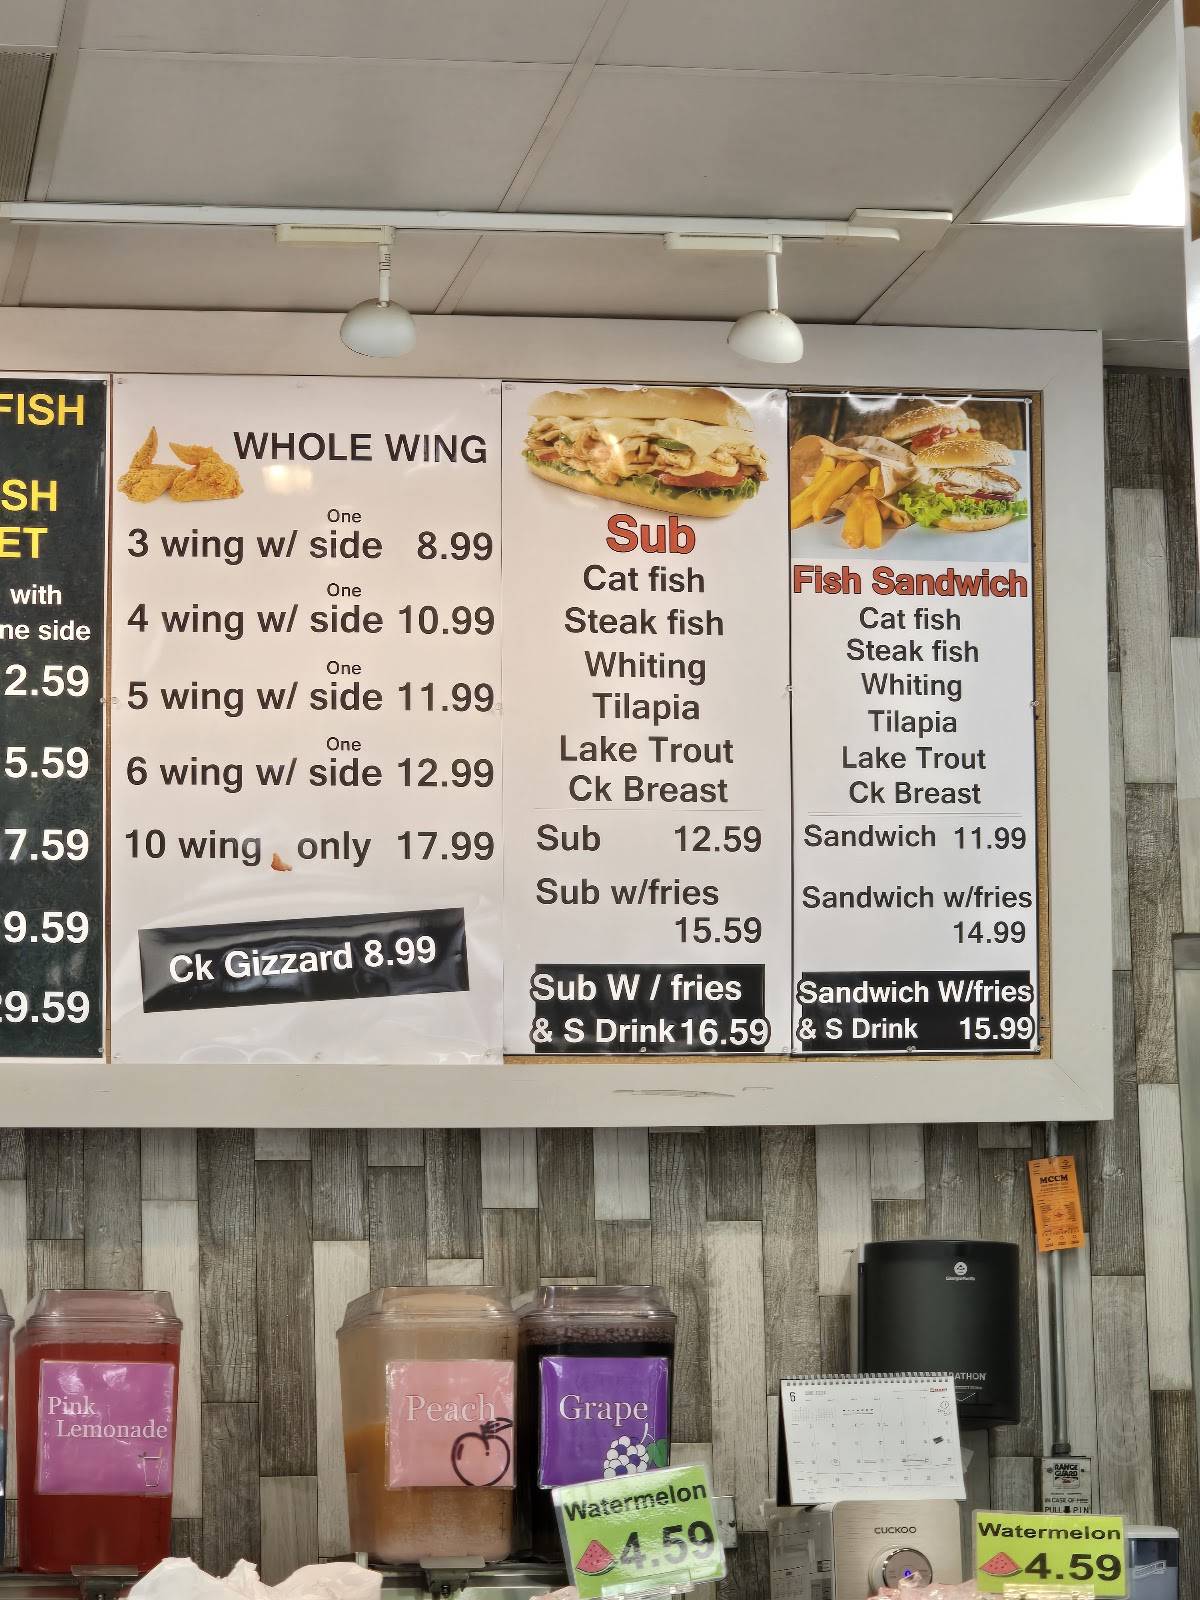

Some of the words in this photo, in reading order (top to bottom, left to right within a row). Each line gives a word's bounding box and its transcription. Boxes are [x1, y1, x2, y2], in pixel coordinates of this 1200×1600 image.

[234, 432, 372, 461] WHOLE
[385, 434, 486, 463] WING
[328, 509, 361, 522] One
[0, 527, 48, 558] ET
[128, 528, 148, 557] 3
[161, 529, 243, 565] wing
[257, 530, 298, 557] w/
[310, 530, 382, 558] side
[418, 531, 492, 560] 8.99
[605, 514, 697, 555] Sub
[327, 583, 361, 597] One
[584, 565, 638, 591] Cat
[649, 566, 704, 592] fish
[794, 565, 861, 594] Fish
[872, 566, 1027, 597] Sandwich
[10, 584, 61, 604] with
[39, 620, 90, 640] side
[128, 604, 148, 632] 4
[162, 604, 243, 640] wing
[257, 604, 298, 632] w/
[311, 605, 383, 633] side
[399, 605, 494, 635] 10.99
[565, 607, 657, 634] Steak
[667, 609, 723, 635] fish
[860, 607, 905, 629] Cat
[914, 608, 960, 630] fish
[847, 638, 923, 661] Steak
[932, 640, 978, 662] fish
[5, 664, 88, 696] 2.59
[327, 661, 361, 674] One
[585, 651, 705, 686] Whiting
[128, 682, 148, 709] 5
[161, 682, 243, 717] wing
[257, 682, 298, 709] w/
[310, 682, 382, 710] side
[399, 682, 493, 712] 11.99
[861, 673, 961, 702] Whiting
[592, 693, 699, 726] Tilapia
[868, 710, 956, 738] Tilapia
[327, 737, 361, 751] One
[561, 735, 637, 762] Lake
[649, 736, 733, 763] Trout
[843, 746, 906, 768] Lake
[916, 747, 986, 769] Trout
[5, 747, 88, 778] 5.59
[160, 757, 242, 793] wing
[256, 758, 297, 785] w/
[310, 758, 382, 786] side
[398, 758, 493, 787] 12.99
[569, 775, 612, 801] Ck
[625, 776, 728, 802] Breast
[850, 781, 885, 803] Ck
[896, 782, 981, 804] Breast
[5, 829, 88, 860] 7.59
[126, 830, 165, 858] 10
[179, 830, 260, 866] wing
[298, 831, 371, 867] only
[398, 831, 494, 860] 17.99
[537, 824, 600, 851] Sub
[675, 826, 761, 852] 12.59
[804, 824, 935, 847] Sandwich
[955, 827, 1026, 849] 11.99
[537, 878, 599, 904] Sub
[611, 879, 718, 905] w/fries
[803, 886, 933, 908] Sandwich
[944, 886, 1032, 908] w/fries
[4, 911, 88, 943] 9.59
[676, 917, 761, 943] 15.59
[954, 921, 1025, 943] 14.99
[169, 954, 214, 982] Ck
[225, 942, 352, 978] Gizzard
[365, 936, 435, 967] 8.99
[532, 975, 596, 1001] Sub
[607, 974, 640, 1000] W
[671, 974, 741, 1000] fries
[799, 981, 929, 1004] Sandwich
[938, 982, 1032, 1004] W/fries
[0, 991, 89, 1023] 9.59
[532, 1018, 552, 1043] &
[564, 1018, 584, 1042] S
[595, 1018, 676, 1043] Drink
[681, 1019, 769, 1045] 16.59
[799, 1018, 816, 1040] &
[826, 1018, 842, 1039] S
[853, 1018, 918, 1038] Drink
[960, 1017, 1033, 1040] 15.99
[1039, 1174, 1068, 1184] MCCM
[46, 1394, 97, 1416] Pink
[405, 1394, 496, 1424] Peach
[558, 1393, 650, 1428] Grape
[56, 1419, 168, 1440] Lemonade
[564, 1482, 708, 1524] Watermelon
[874, 1526, 917, 1534] CUCKOO
[978, 1523, 1120, 1539] Watermelon
[620, 1520, 715, 1571] 4.59
[1024, 1552, 1121, 1582] 4.59
